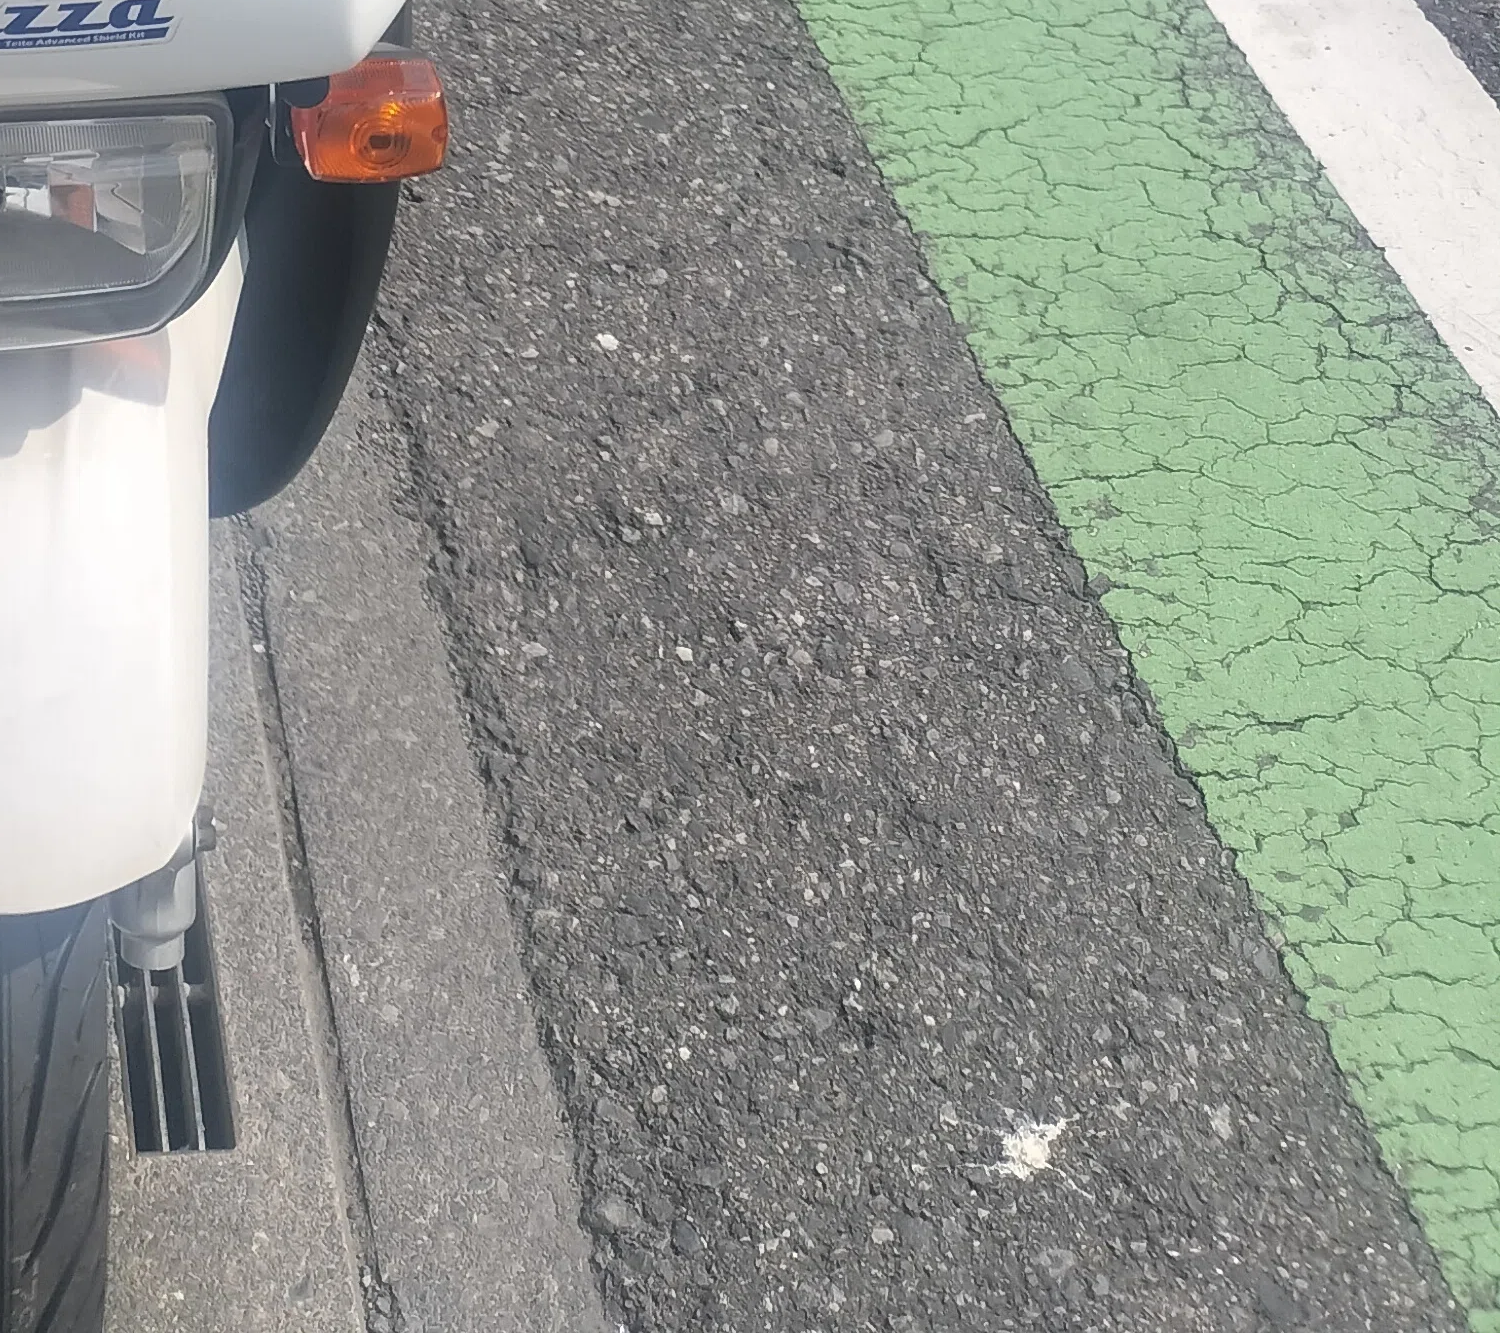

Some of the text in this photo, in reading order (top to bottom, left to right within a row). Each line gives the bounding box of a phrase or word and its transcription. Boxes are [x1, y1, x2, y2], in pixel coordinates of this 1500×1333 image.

[35, 34, 91, 46] Advanced
[92, 32, 127, 42] Shield
[128, 31, 146, 40] Kit
